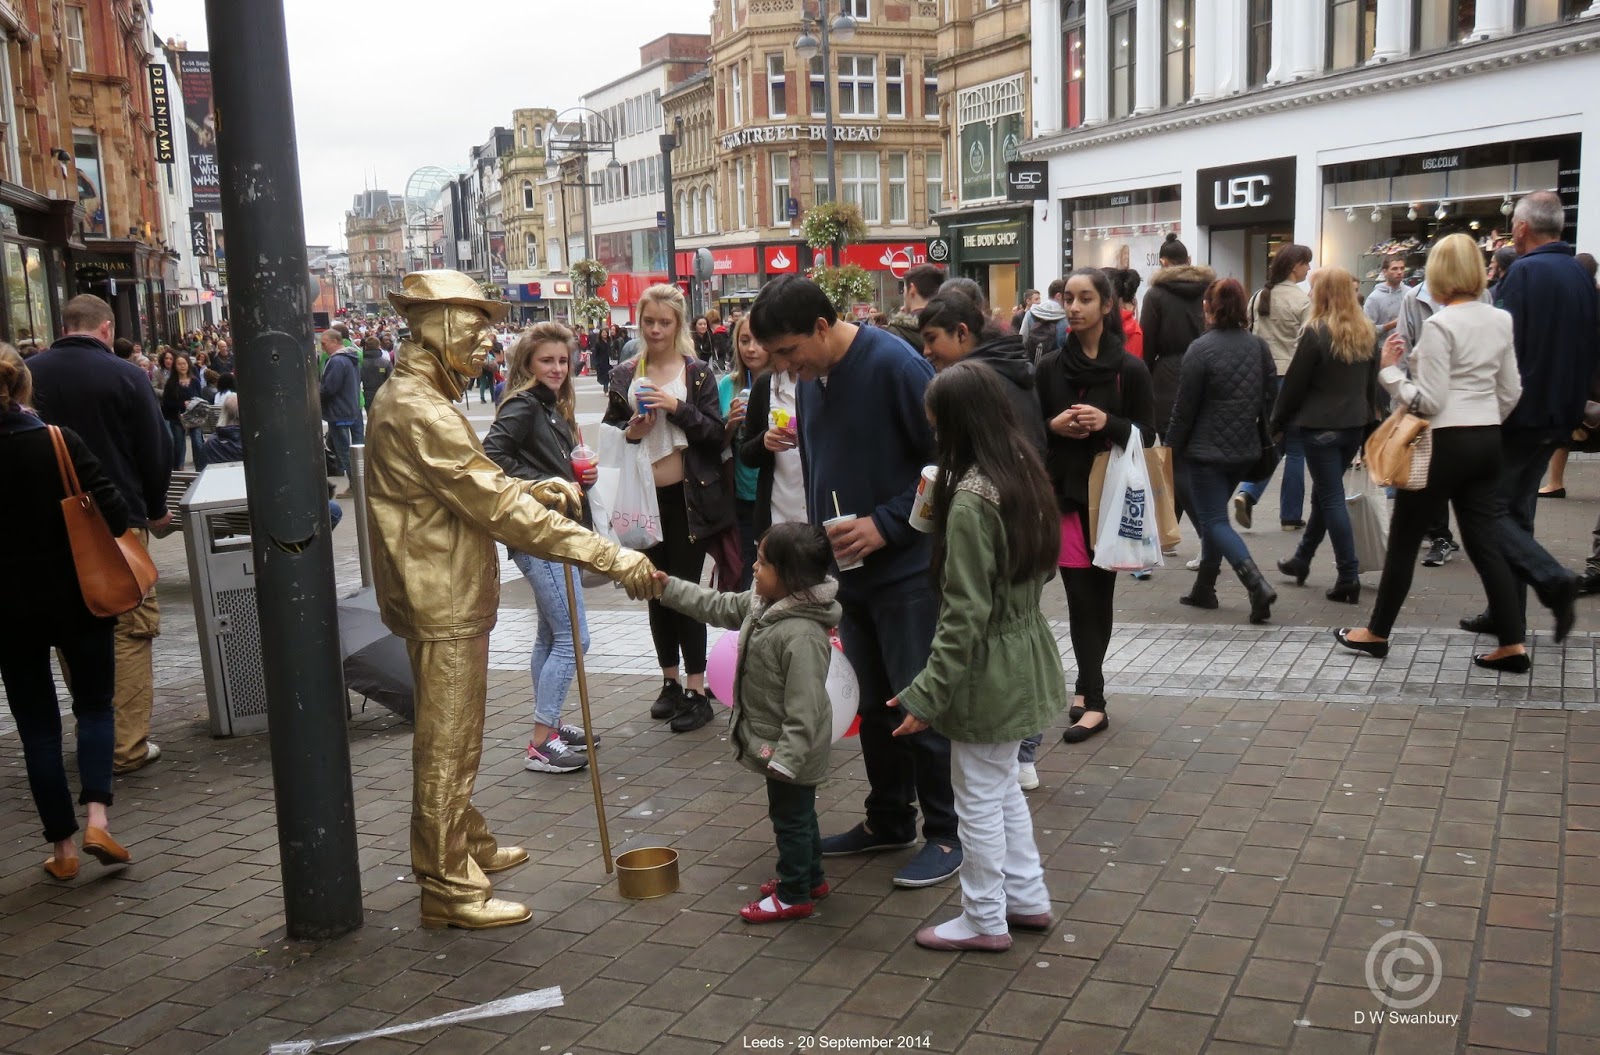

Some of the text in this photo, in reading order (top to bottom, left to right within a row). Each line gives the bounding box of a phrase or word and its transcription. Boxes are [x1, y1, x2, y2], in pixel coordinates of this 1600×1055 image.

[152, 68, 172, 160] DEBENHAMS
[742, 126, 802, 145] STREET
[809, 126, 882, 142] BUREAU
[190, 154, 214, 166] THE
[1422, 156, 1458, 170] USC.CO.UK
[1010, 172, 1042, 184] USC
[1214, 174, 1270, 210] USC
[1110, 196, 1130, 206] USC.CO.UK
[193, 222, 206, 254] ZARA
[963, 235, 976, 247] THE
[977, 234, 996, 246] BODY
